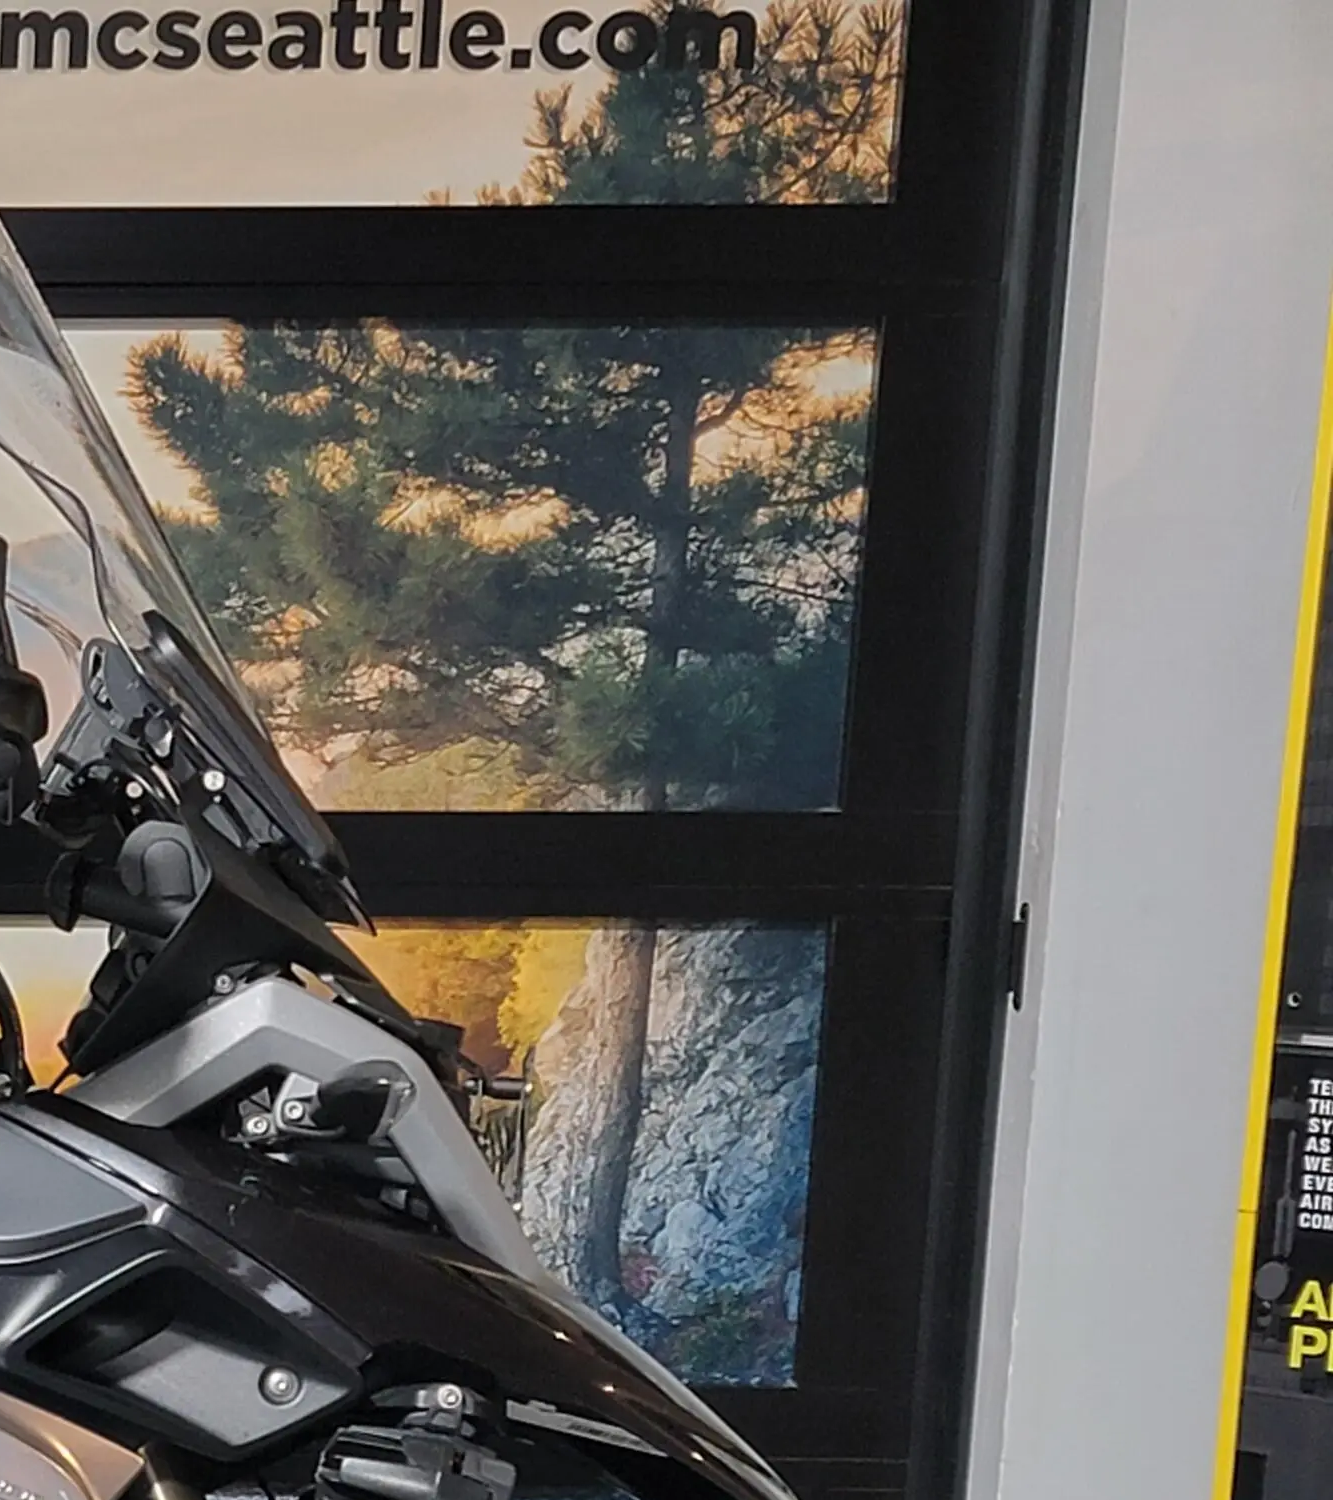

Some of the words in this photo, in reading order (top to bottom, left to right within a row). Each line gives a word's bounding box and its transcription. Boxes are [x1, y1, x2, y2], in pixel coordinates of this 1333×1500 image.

[1309, 1078, 1333, 1096] TE
[1308, 1097, 1333, 1116] TH
[1307, 1116, 1333, 1135] SY
[1290, 1279, 1333, 1321] A
[1288, 1324, 1333, 1372] P
